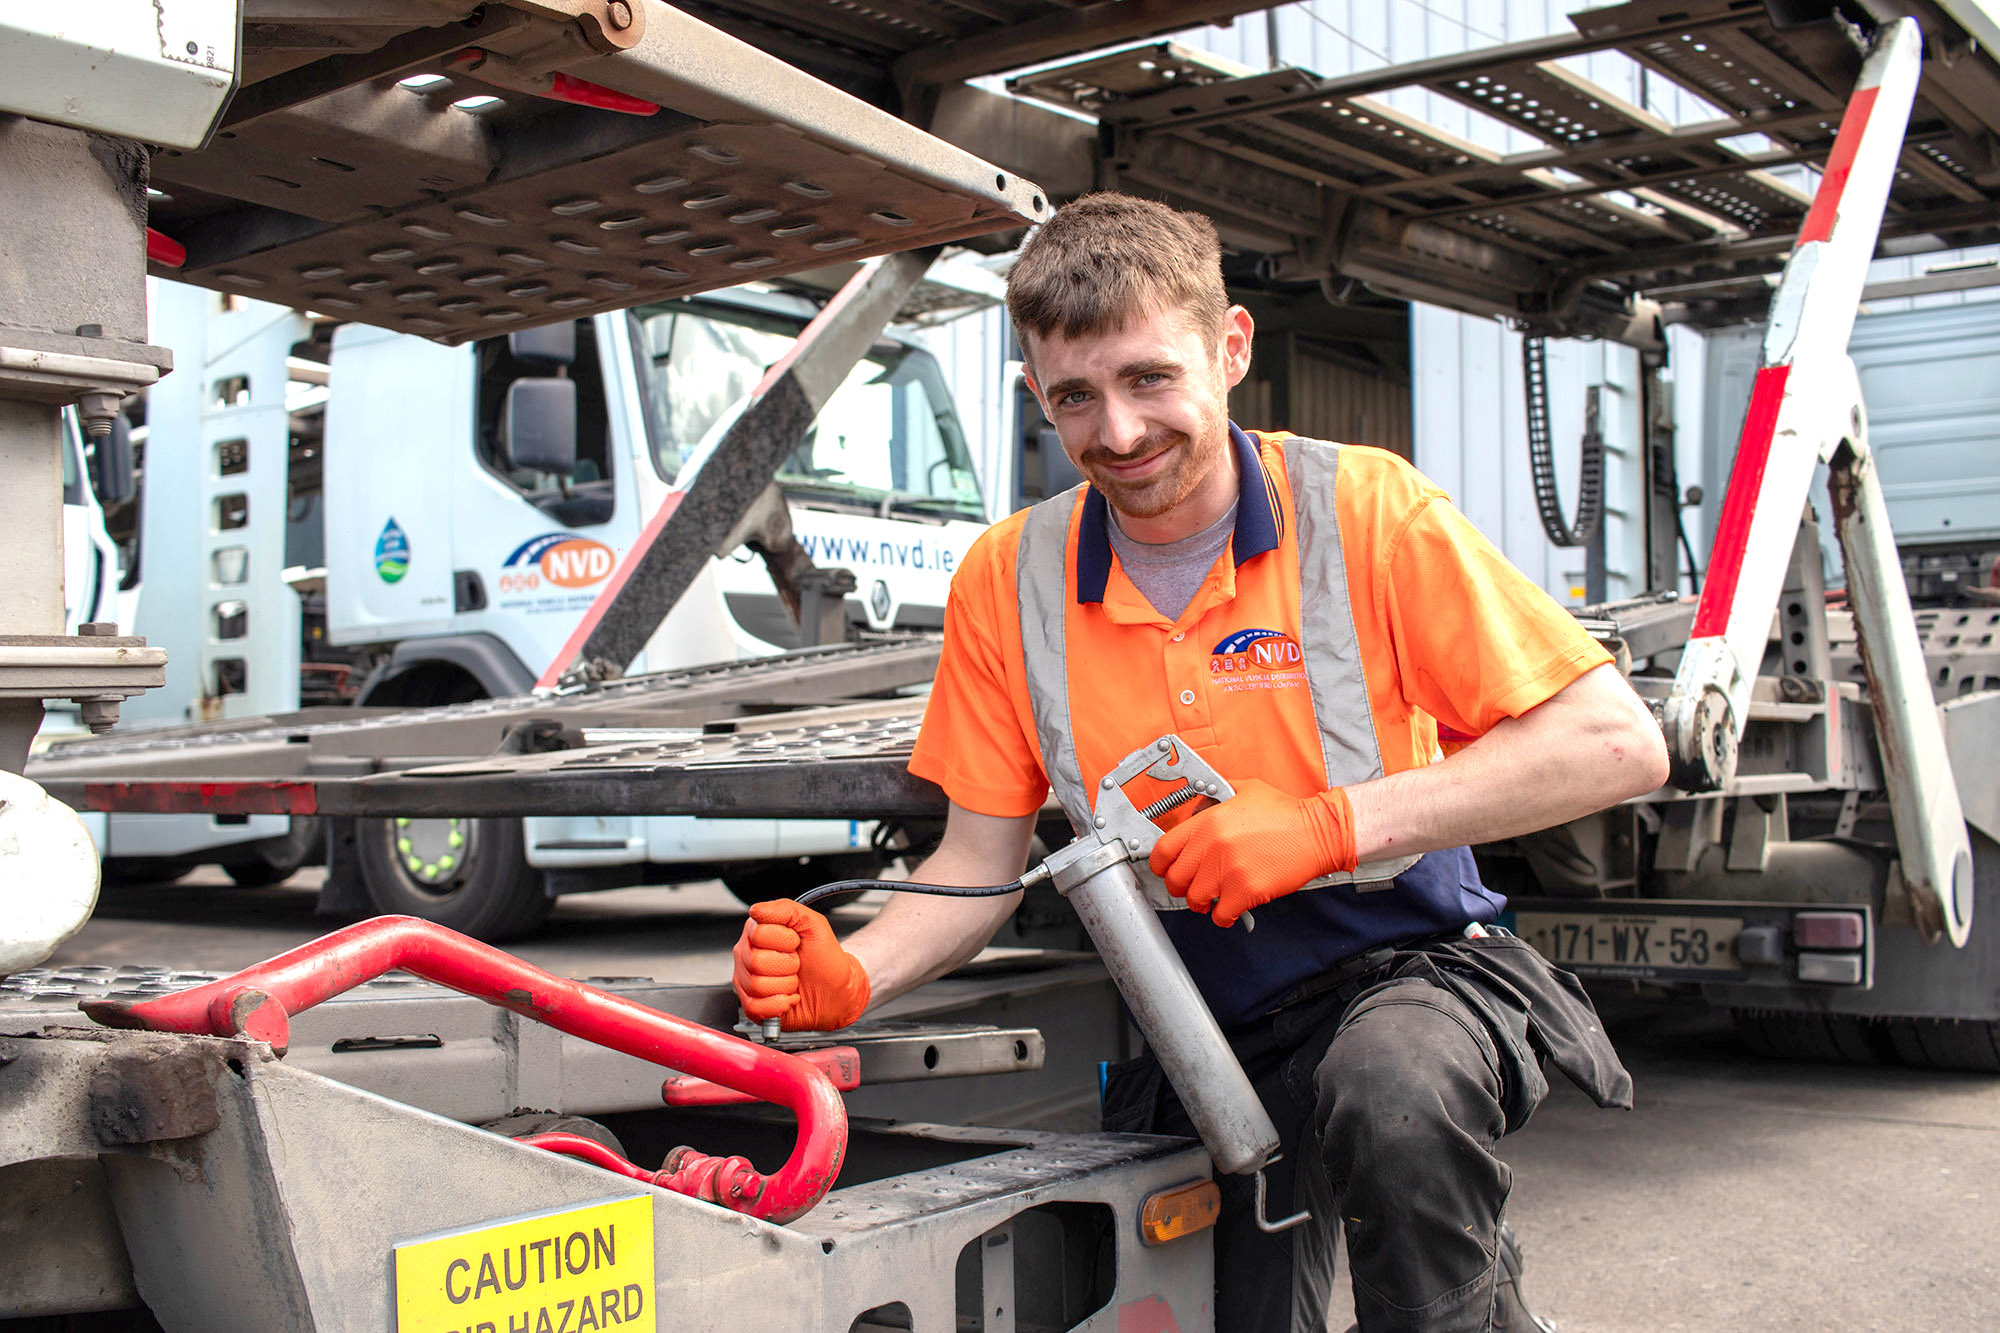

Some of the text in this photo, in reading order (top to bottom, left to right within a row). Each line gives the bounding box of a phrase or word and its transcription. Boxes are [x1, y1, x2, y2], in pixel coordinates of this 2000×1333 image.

[549, 546, 612, 581] NVD
[1253, 642, 1300, 664] NVD
[1211, 675, 1244, 686] NATIONAL
[1270, 671, 1307, 681] DISTRIBUTIO
[1551, 923, 1710, 966] 171-WX-53
[445, 1224, 616, 1305] CAUTION
[508, 1283, 644, 1333] HAZARD
